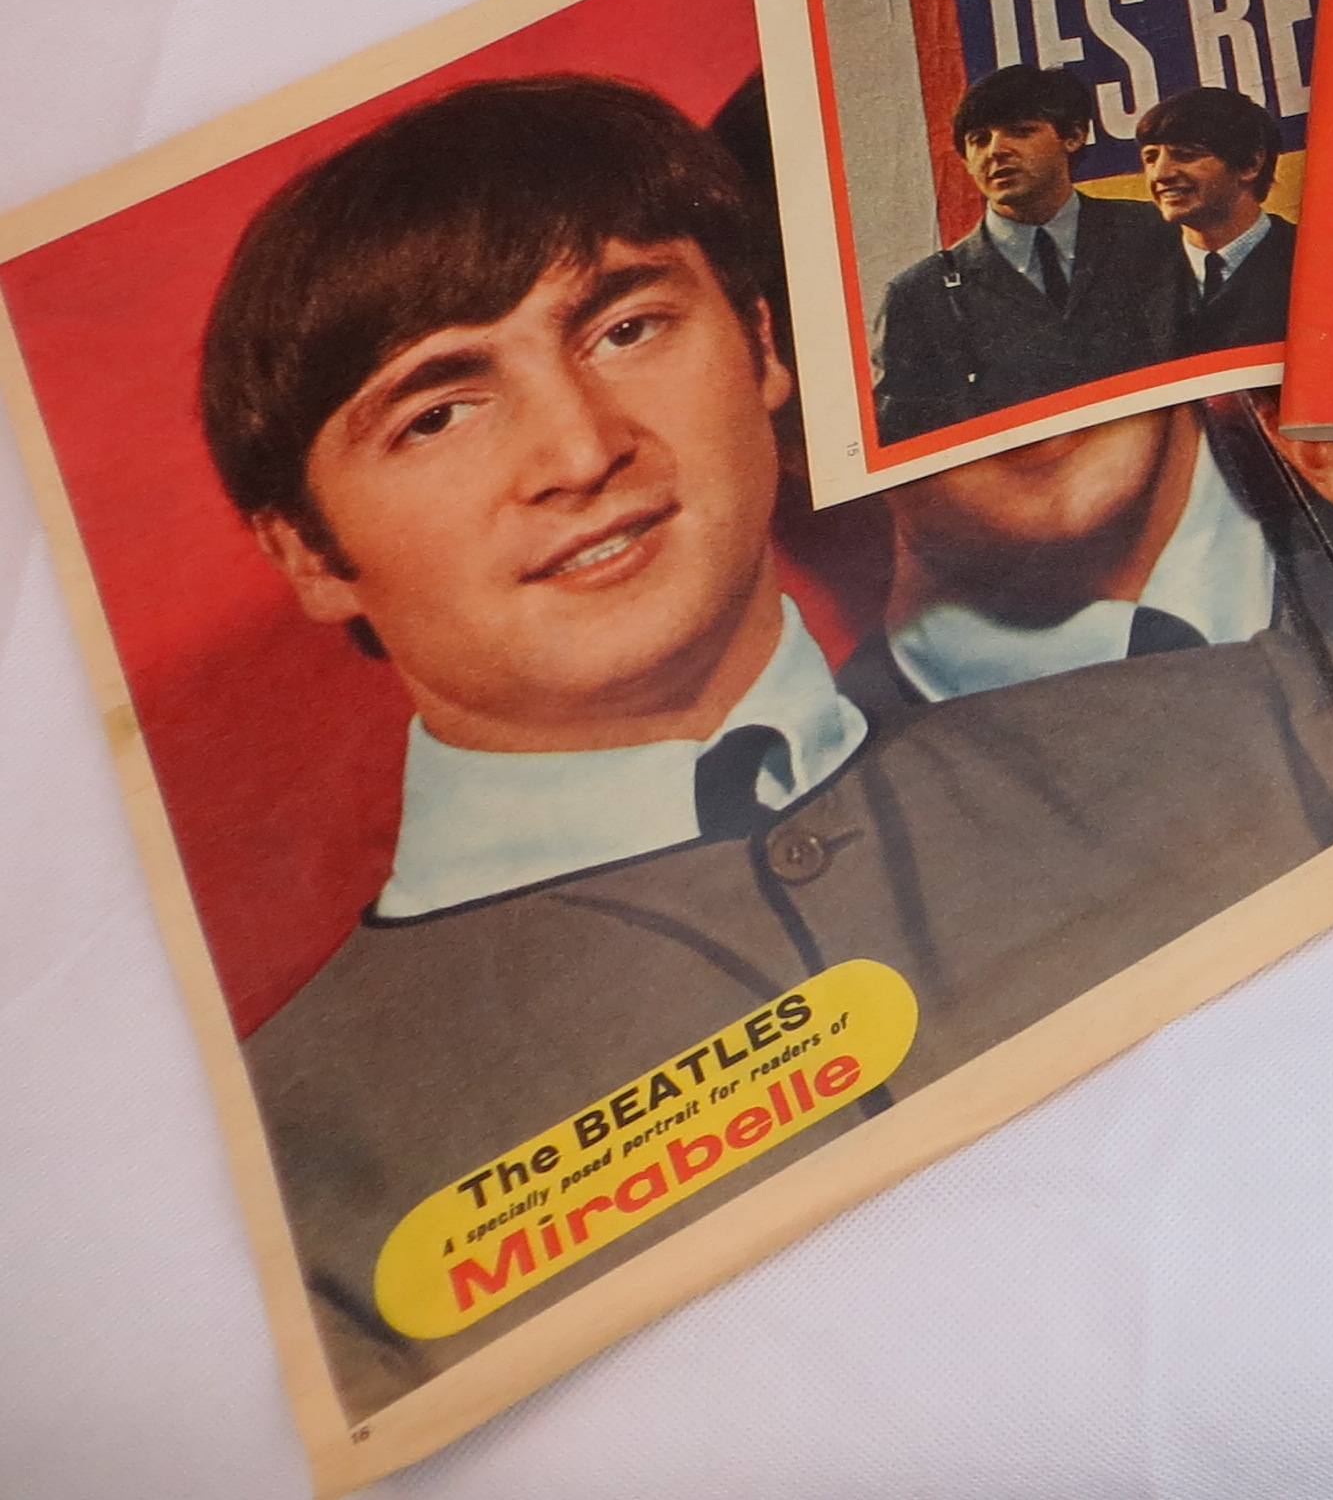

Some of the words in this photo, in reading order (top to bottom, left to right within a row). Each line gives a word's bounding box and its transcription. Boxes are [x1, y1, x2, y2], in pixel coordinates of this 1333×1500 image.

[443, 1238, 454, 1257] A
[465, 1186, 551, 1244] specially
[560, 1147, 613, 1194] posed
[622, 1100, 700, 1158] portrait
[708, 1079, 740, 1105] for
[750, 1032, 821, 1083] readers
[830, 1011, 849, 1036] of
[448, 1055, 862, 1313] Mirabelle
[456, 1144, 562, 1210] The
[573, 993, 812, 1151] BEATLES
